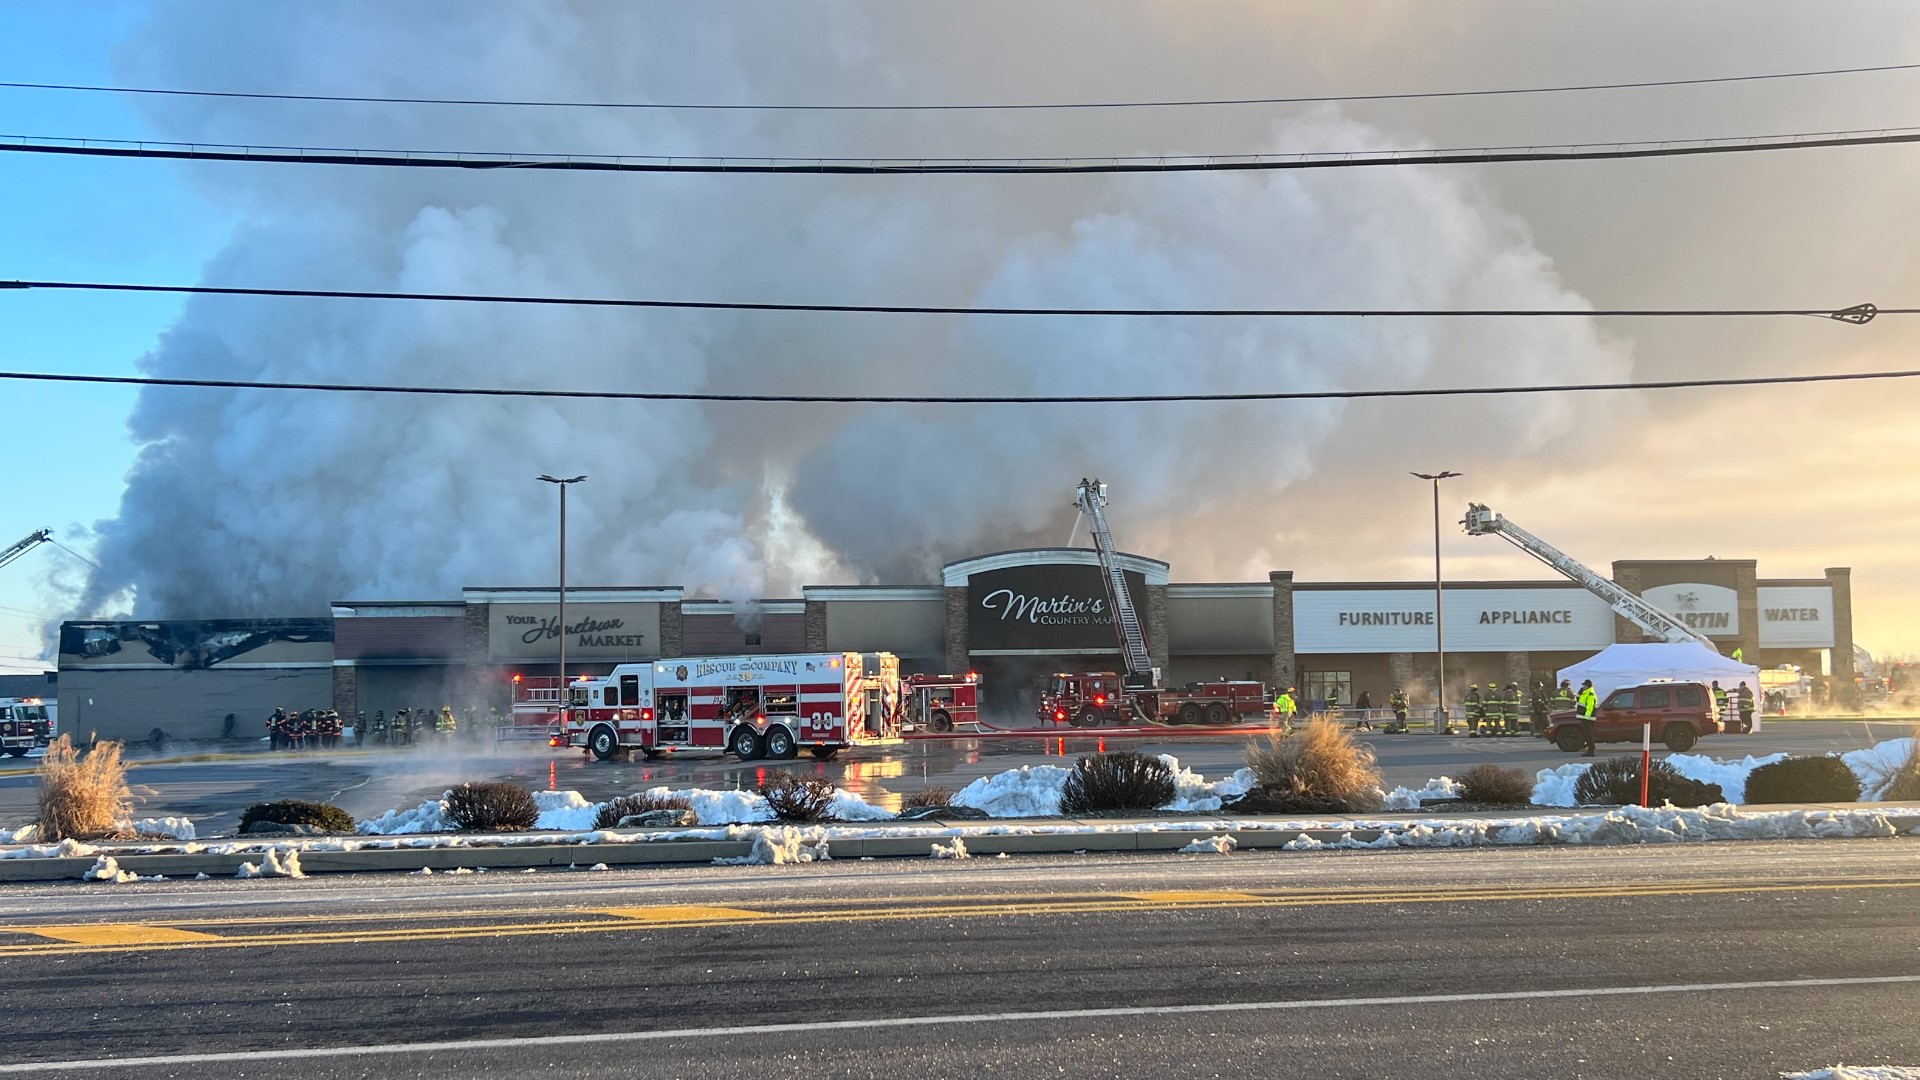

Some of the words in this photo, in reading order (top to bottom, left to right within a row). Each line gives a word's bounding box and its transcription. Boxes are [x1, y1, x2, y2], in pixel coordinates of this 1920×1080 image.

[982, 589, 1105, 624] Martin's
[505, 615, 538, 625] YOUR
[1040, 615, 1091, 625] COUNTRY
[1339, 612, 1434, 626] FURNITURE
[1479, 610, 1572, 625] APPLIANCE
[1670, 612, 1730, 629] ARTIN
[1765, 608, 1819, 622] WATER
[578, 634, 644, 647] MARKET
[696, 662, 736, 678] RESCUE
[751, 660, 799, 675] COMPANY
[738, 671, 753, 682] 39
